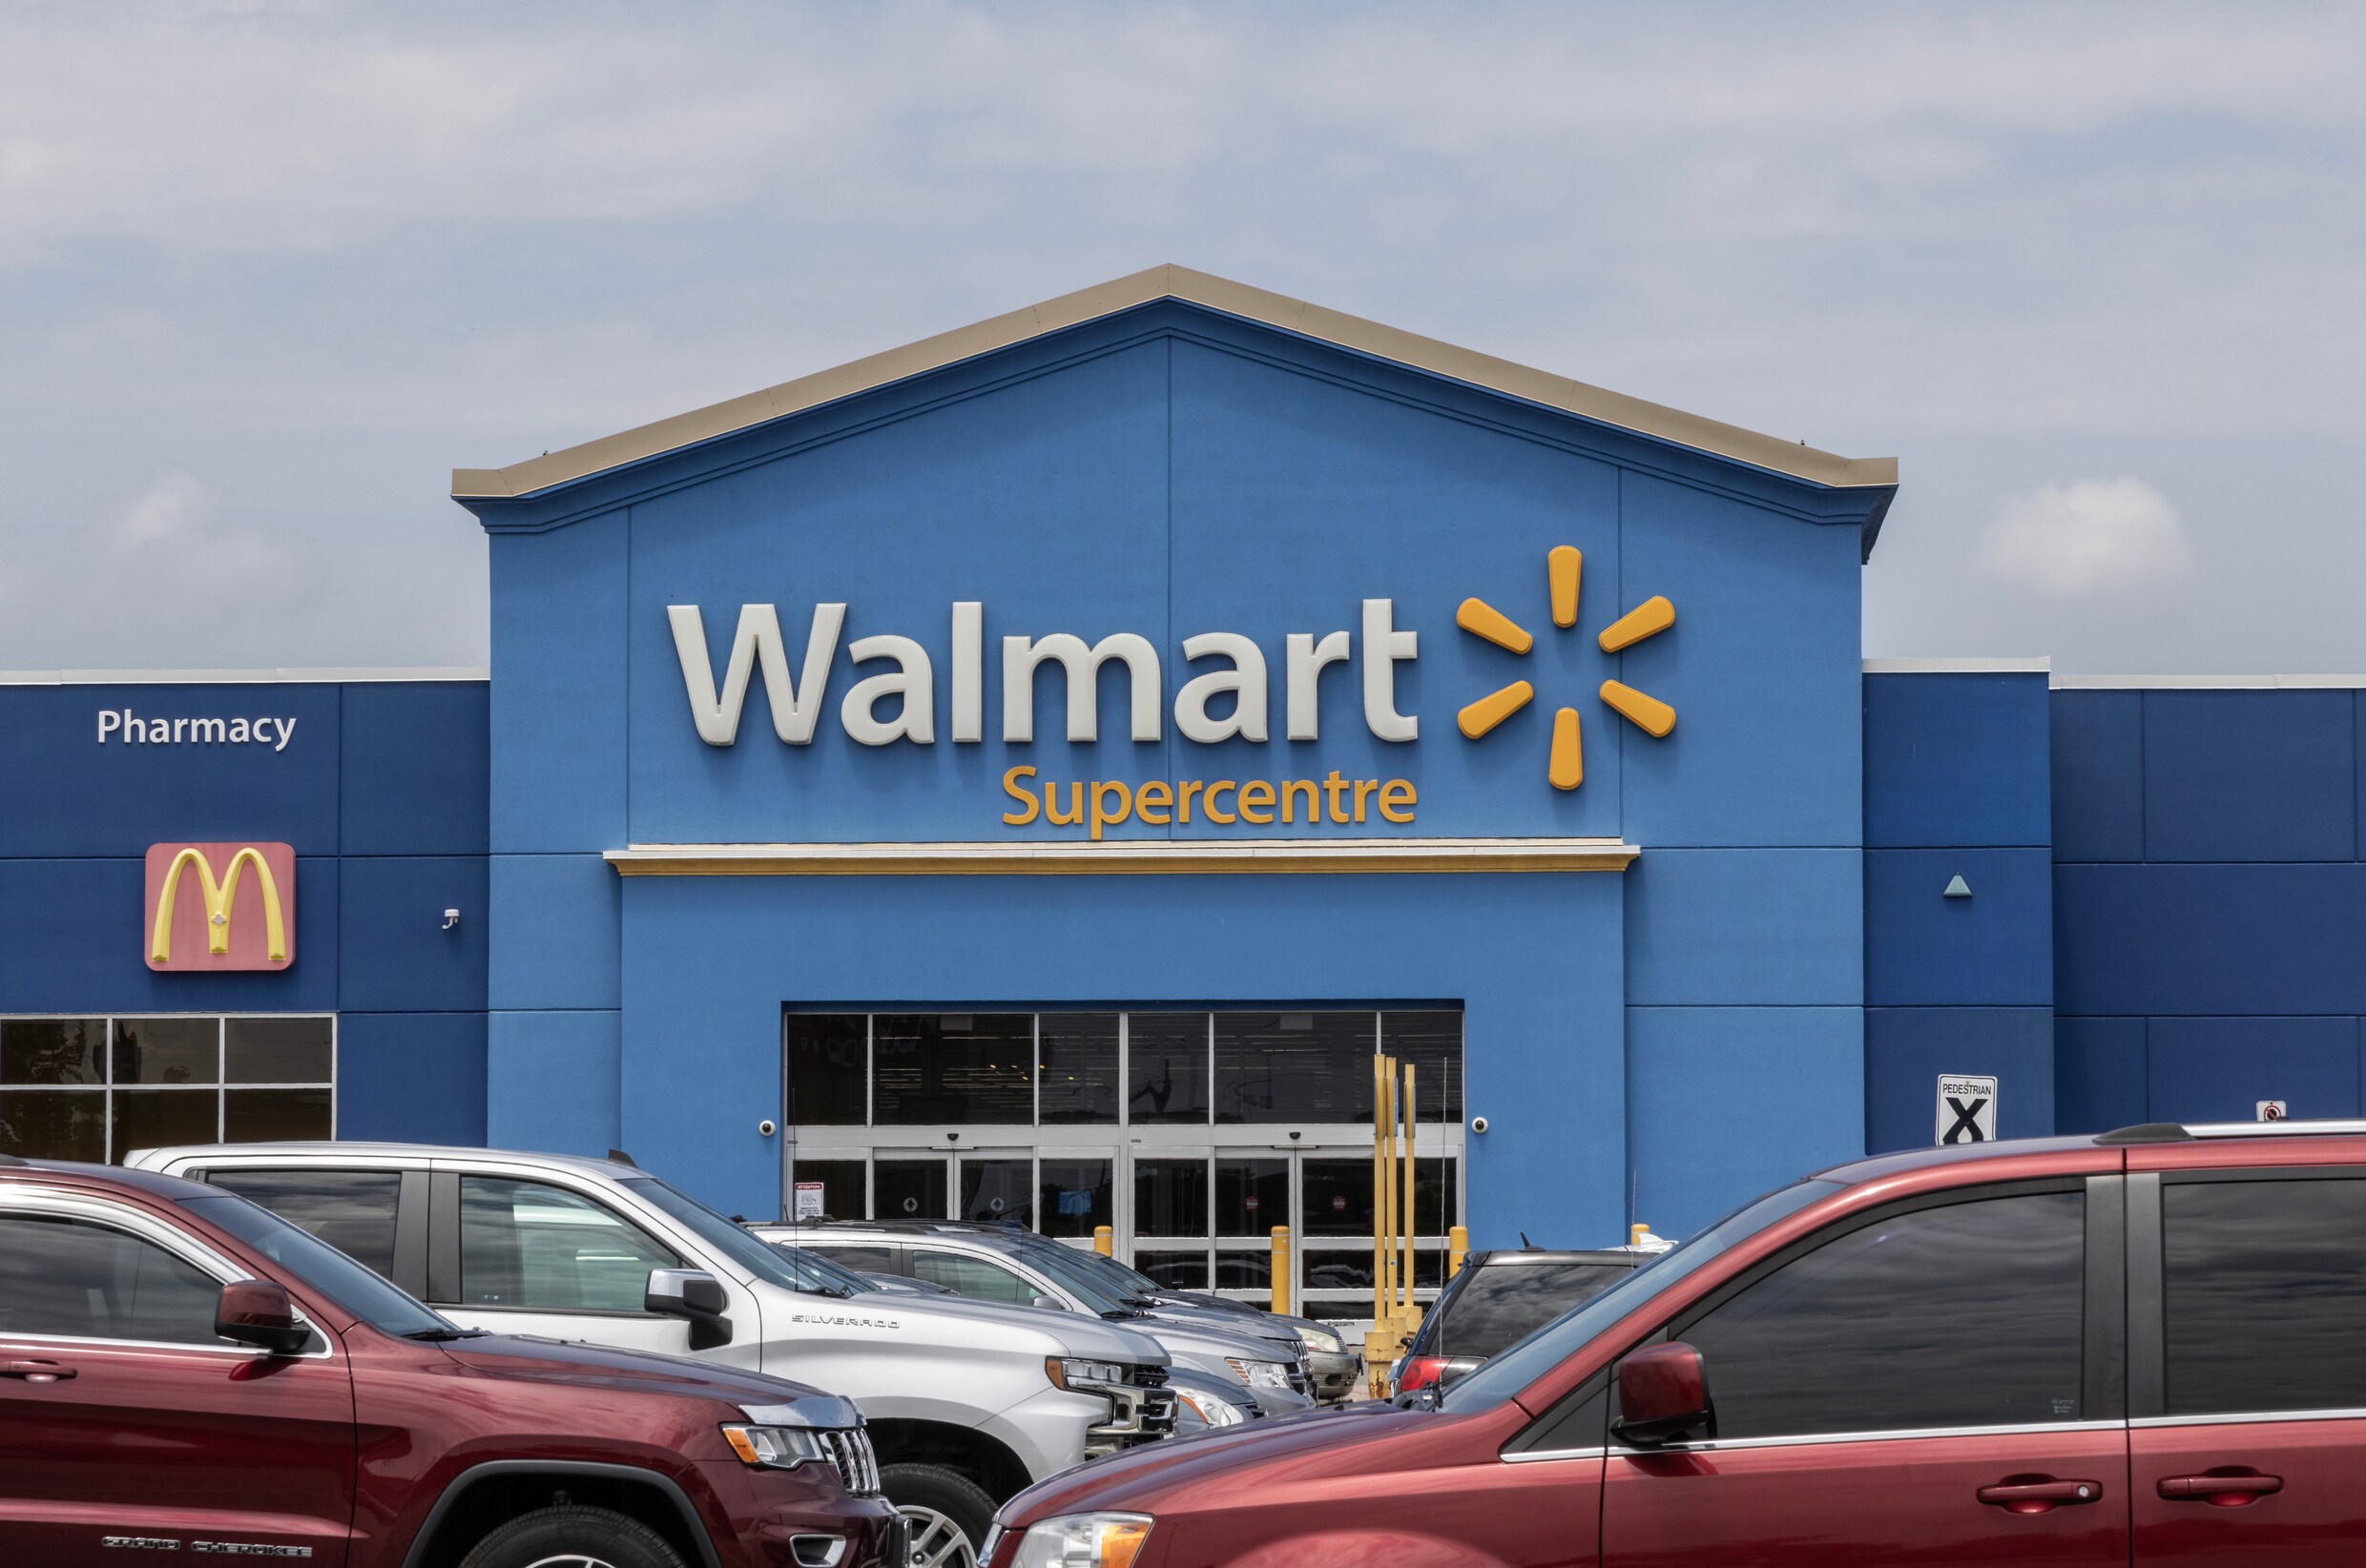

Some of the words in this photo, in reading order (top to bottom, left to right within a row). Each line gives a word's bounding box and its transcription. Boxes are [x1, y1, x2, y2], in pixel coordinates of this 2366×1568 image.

[667, 598, 1419, 746] Walmart
[97, 708, 297, 753] Pharmacy
[1003, 765, 1418, 841] Supercentre
[1942, 1083, 1992, 1095] PEDESTRIAN
[1942, 1097, 1988, 1144] X
[791, 1314, 900, 1329] SILVERADO
[102, 1537, 181, 1550] GRAND
[192, 1541, 313, 1558] CHEROKEE
